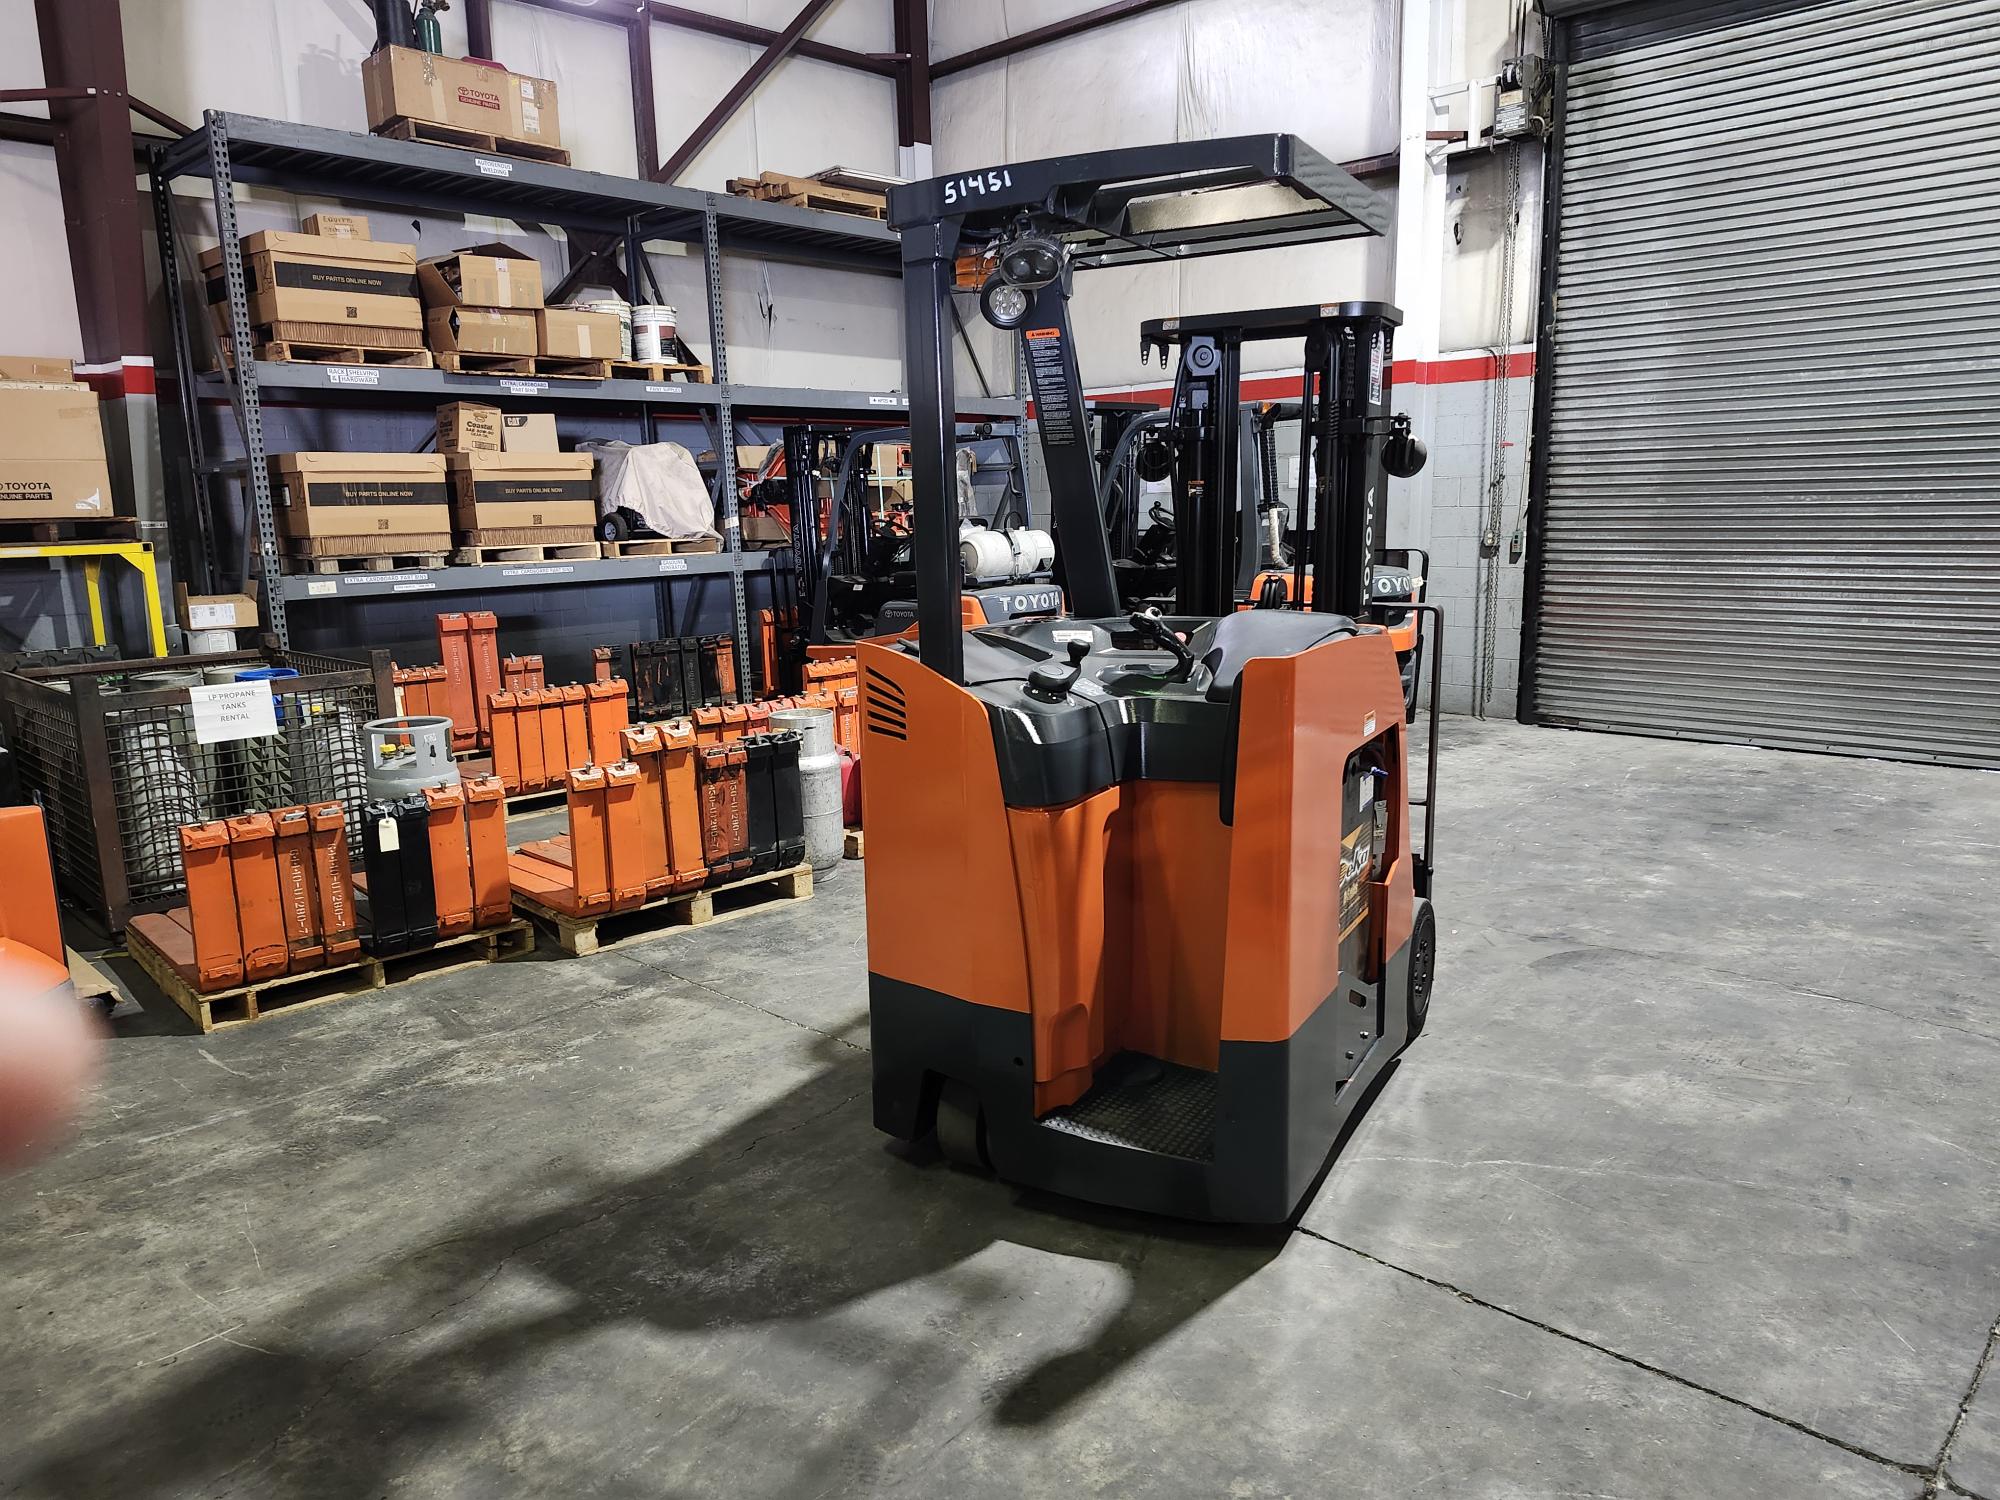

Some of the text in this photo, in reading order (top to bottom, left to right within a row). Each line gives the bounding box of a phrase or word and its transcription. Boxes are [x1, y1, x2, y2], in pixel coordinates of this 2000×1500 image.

[469, 89, 499, 101] TOYOTA
[482, 100, 499, 109] PARTS
[482, 166, 508, 175] WELDING
[944, 170, 1012, 204] 51451
[325, 275, 345, 283] PARTS
[345, 277, 367, 285] ONLINE
[328, 368, 378, 377] RACK SHELVING
[341, 376, 377, 384] HARDWARE
[466, 421, 493, 430] Coastal
[507, 417, 521, 426] CAT
[5, 482, 51, 490] TOYOTA
[378, 490, 399, 498] ONLINE
[399, 490, 414, 498] NOW
[793, 523, 803, 571] TOYOTA
[1362, 486, 1375, 605] TOYOTA
[1000, 591, 1061, 611] TOYOTA
[893, 610, 914, 618] TOYOTA
[208, 690, 256, 701] LP PROPANE
[221, 701, 247, 710] TANKS
[220, 713, 250, 722] RENTAL
